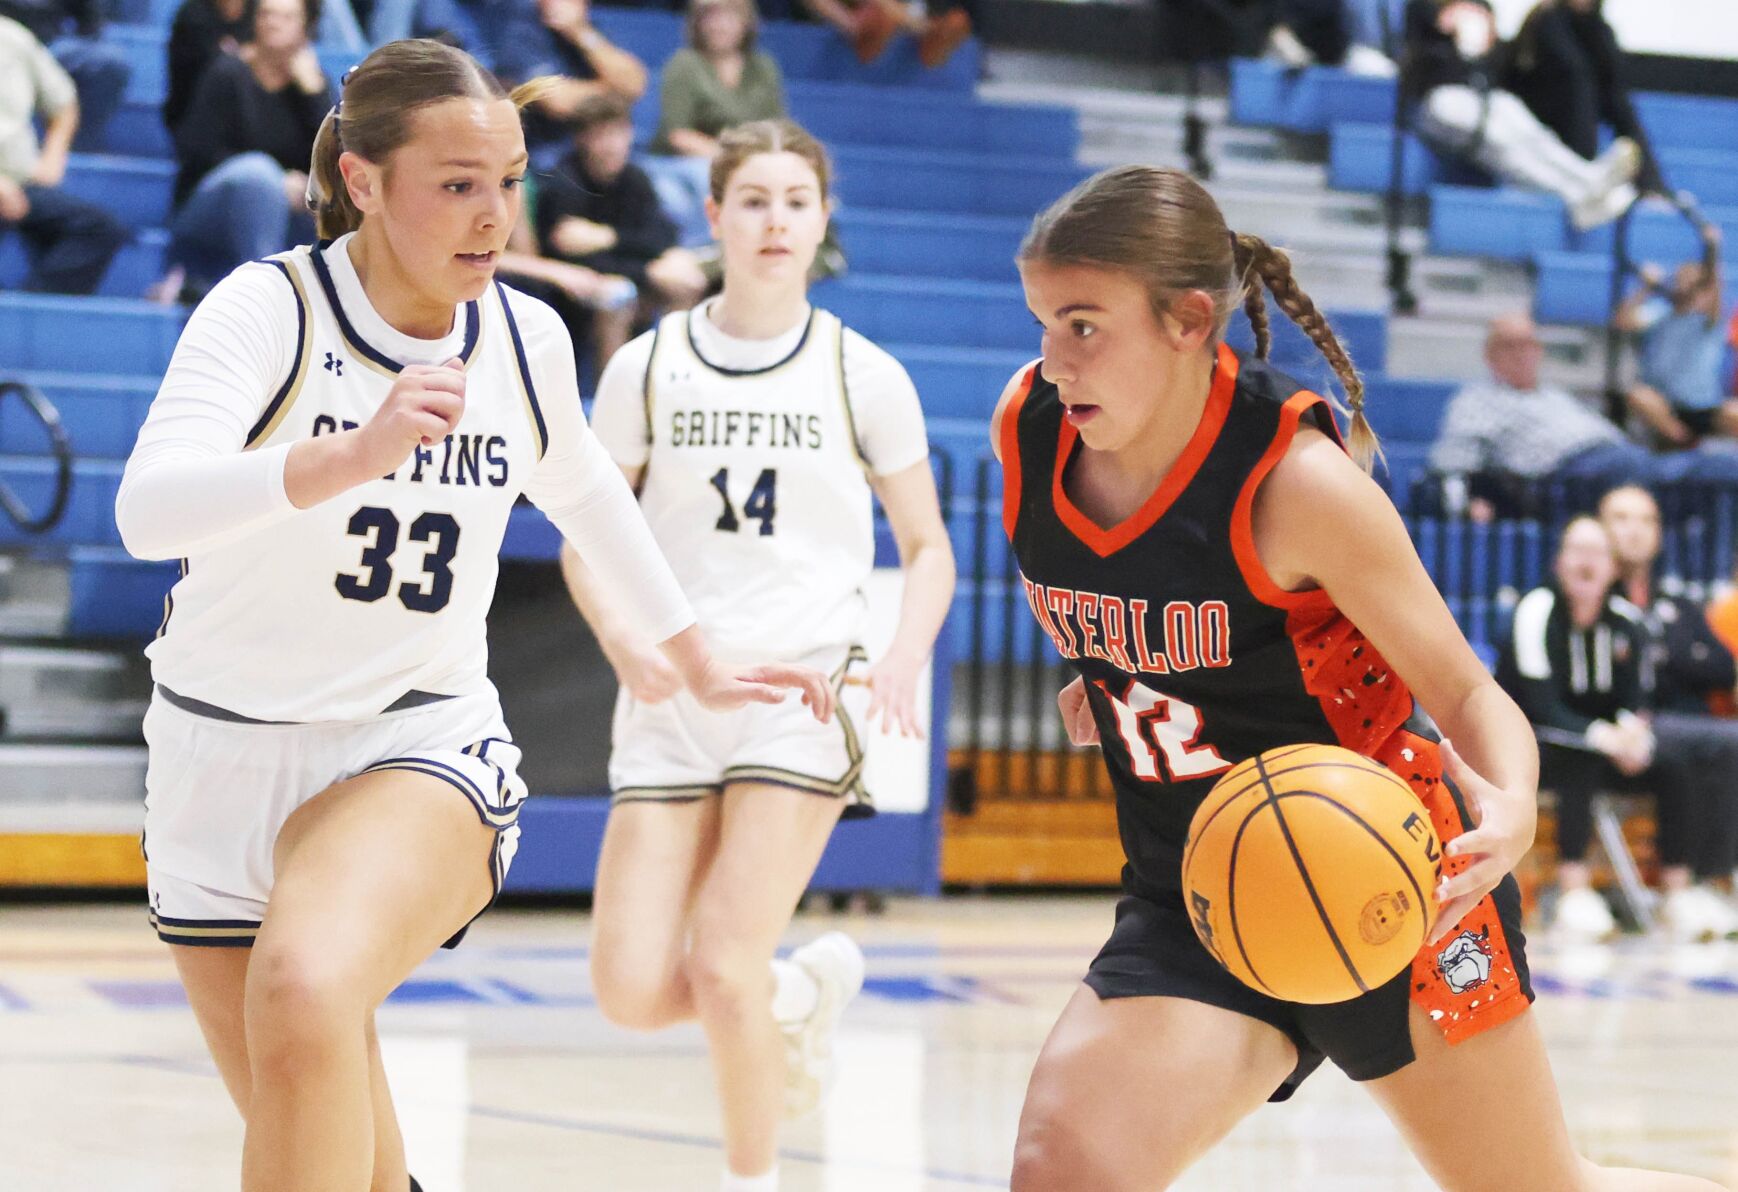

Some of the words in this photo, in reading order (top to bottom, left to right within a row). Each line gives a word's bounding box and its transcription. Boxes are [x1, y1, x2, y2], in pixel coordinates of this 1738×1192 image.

[312, 414, 509, 487] FINS
[671, 410, 823, 450] GRIFFINS
[709, 467, 778, 537] 14
[334, 505, 461, 614] 33
[1091, 677, 1237, 785] 12
